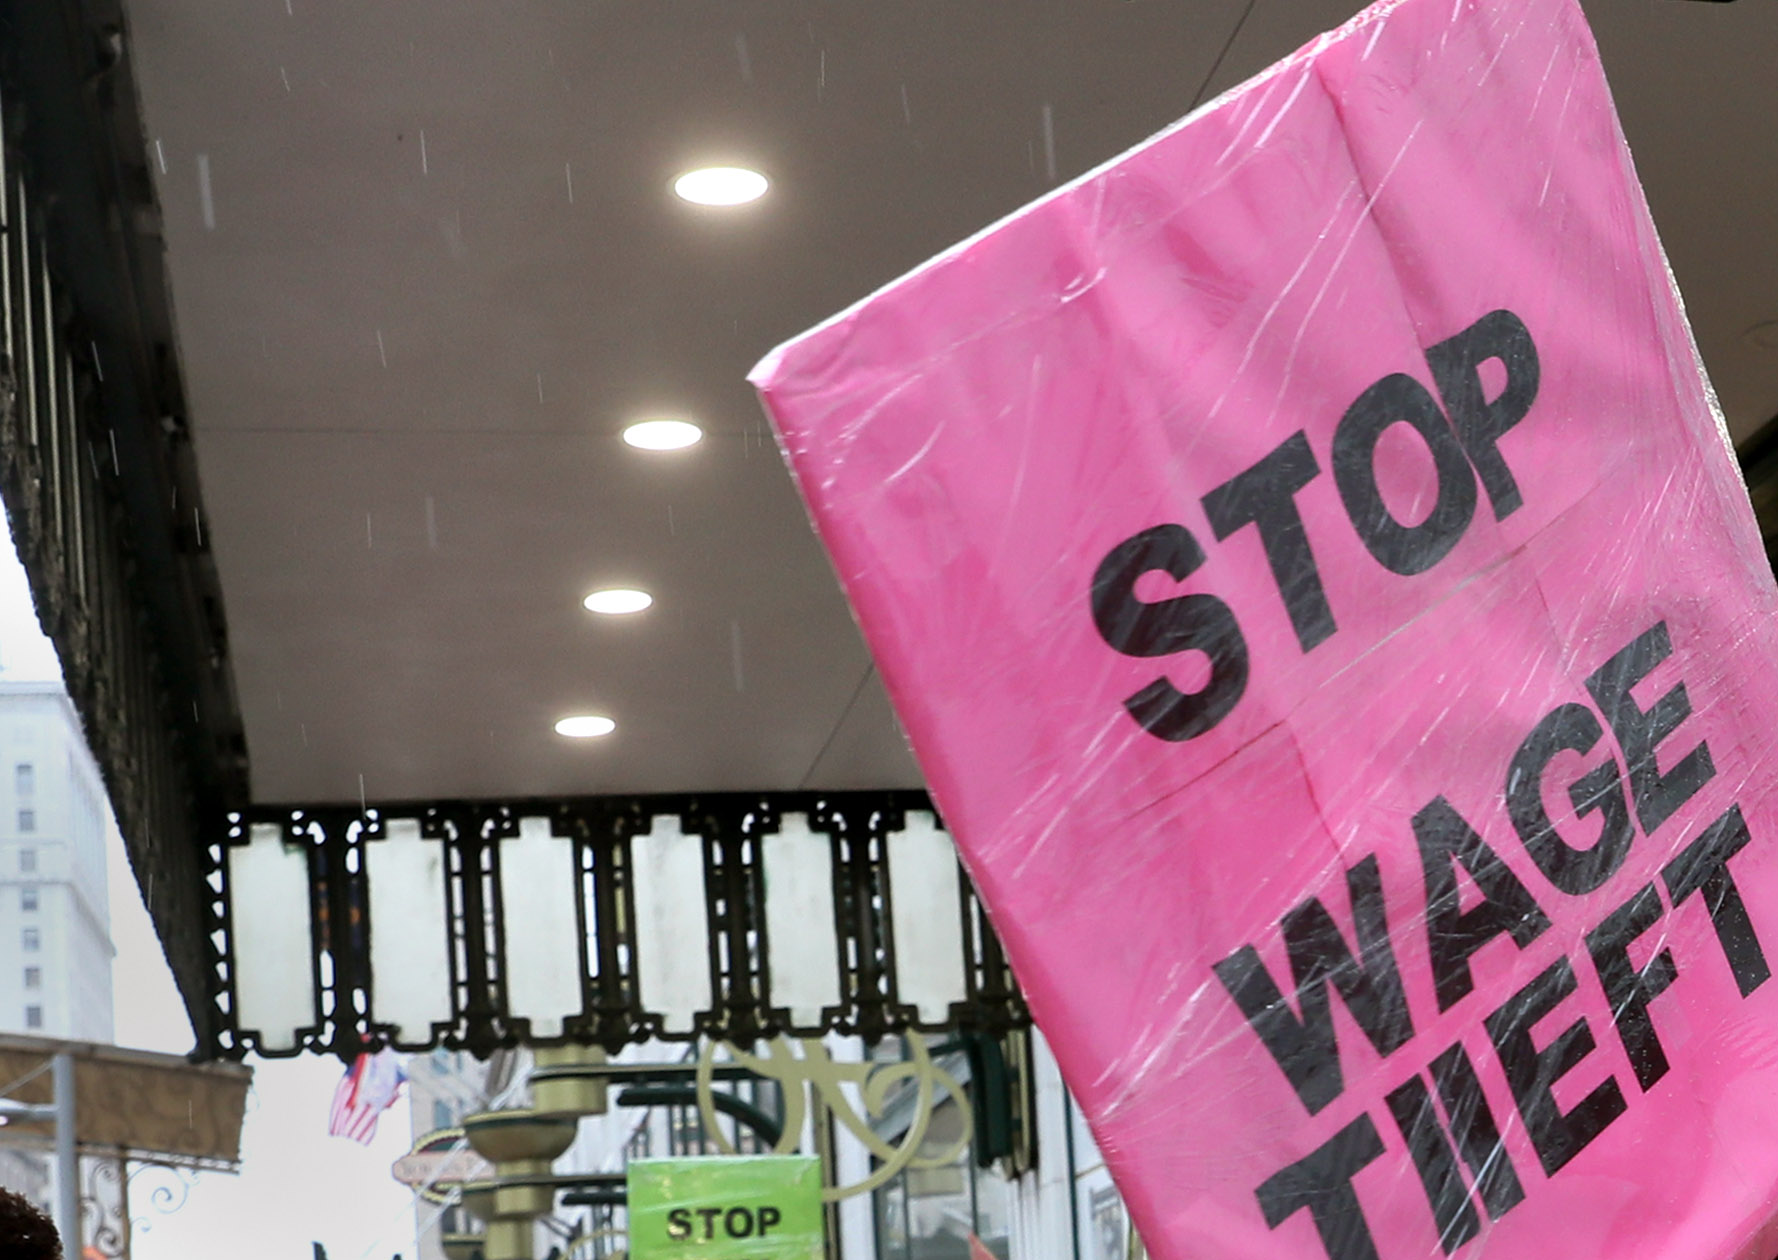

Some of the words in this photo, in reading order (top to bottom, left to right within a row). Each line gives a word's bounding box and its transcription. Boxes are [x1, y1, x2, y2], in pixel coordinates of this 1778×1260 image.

[1089, 308, 1541, 743] STOP
[1212, 620, 1717, 1117] WAGE
[667, 1206, 781, 1241] STOP
